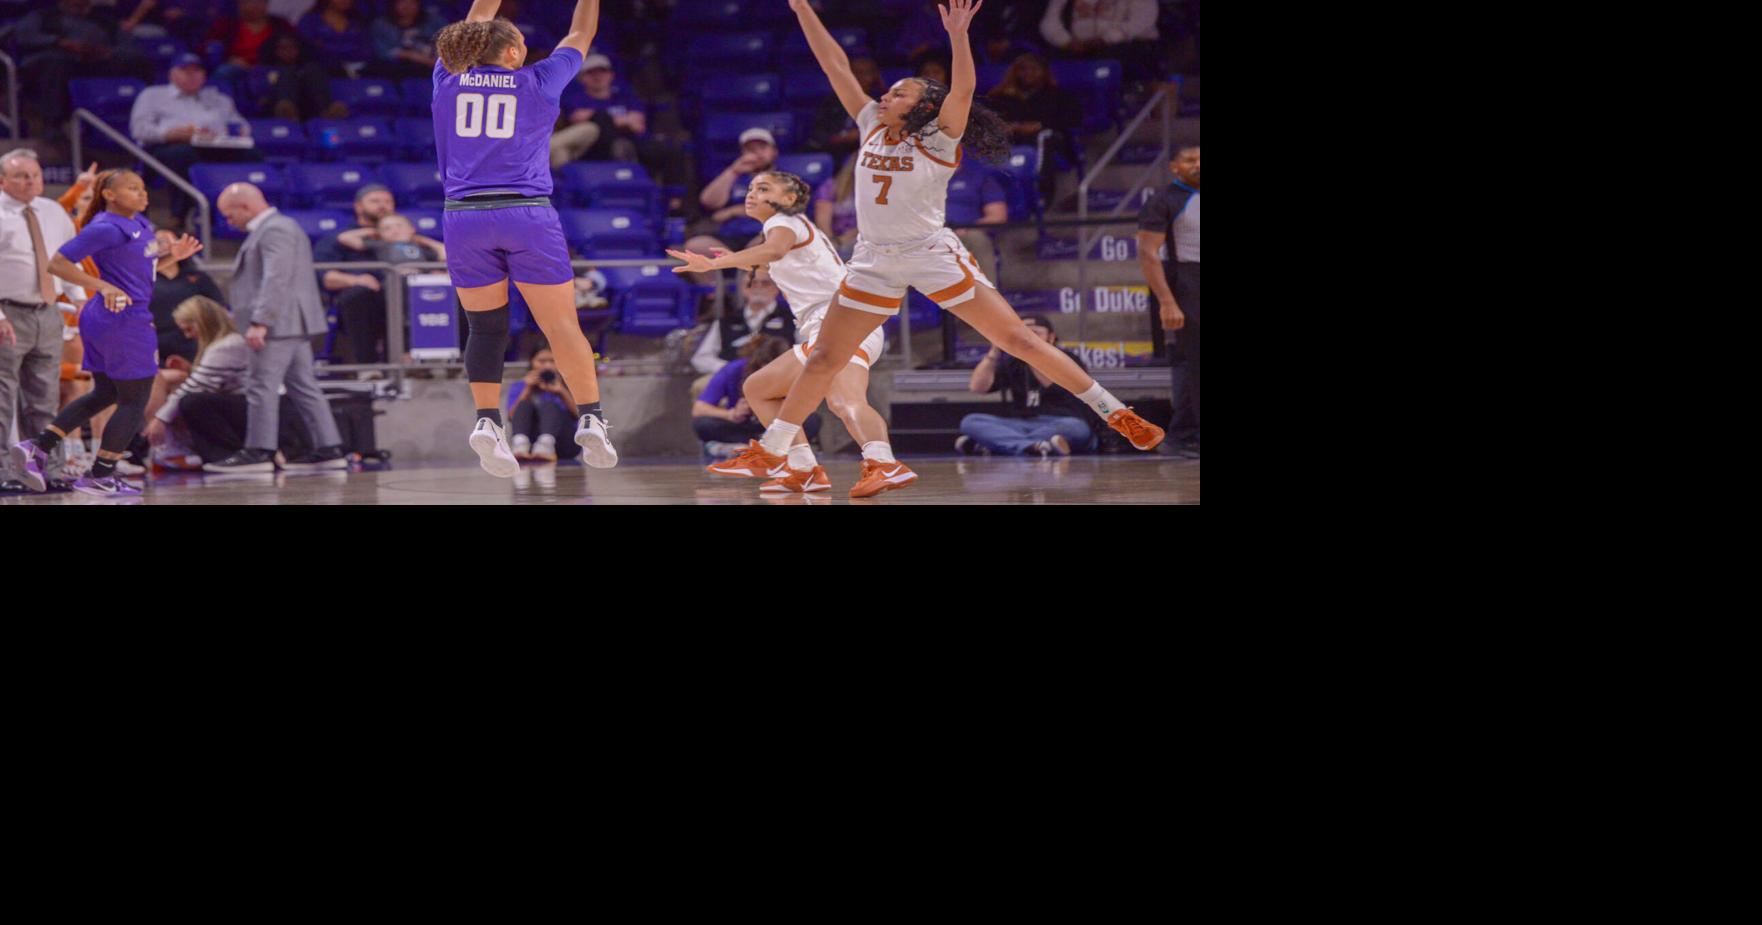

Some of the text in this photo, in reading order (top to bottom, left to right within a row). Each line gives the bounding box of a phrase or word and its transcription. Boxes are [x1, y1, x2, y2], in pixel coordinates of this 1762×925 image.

[459, 73, 517, 89] McDANIEL
[455, 92, 518, 139] 00
[861, 151, 915, 172] TEXAS
[872, 174, 893, 206] 7
[1101, 235, 1129, 261] Go
[1074, 342, 1125, 368] kes!
